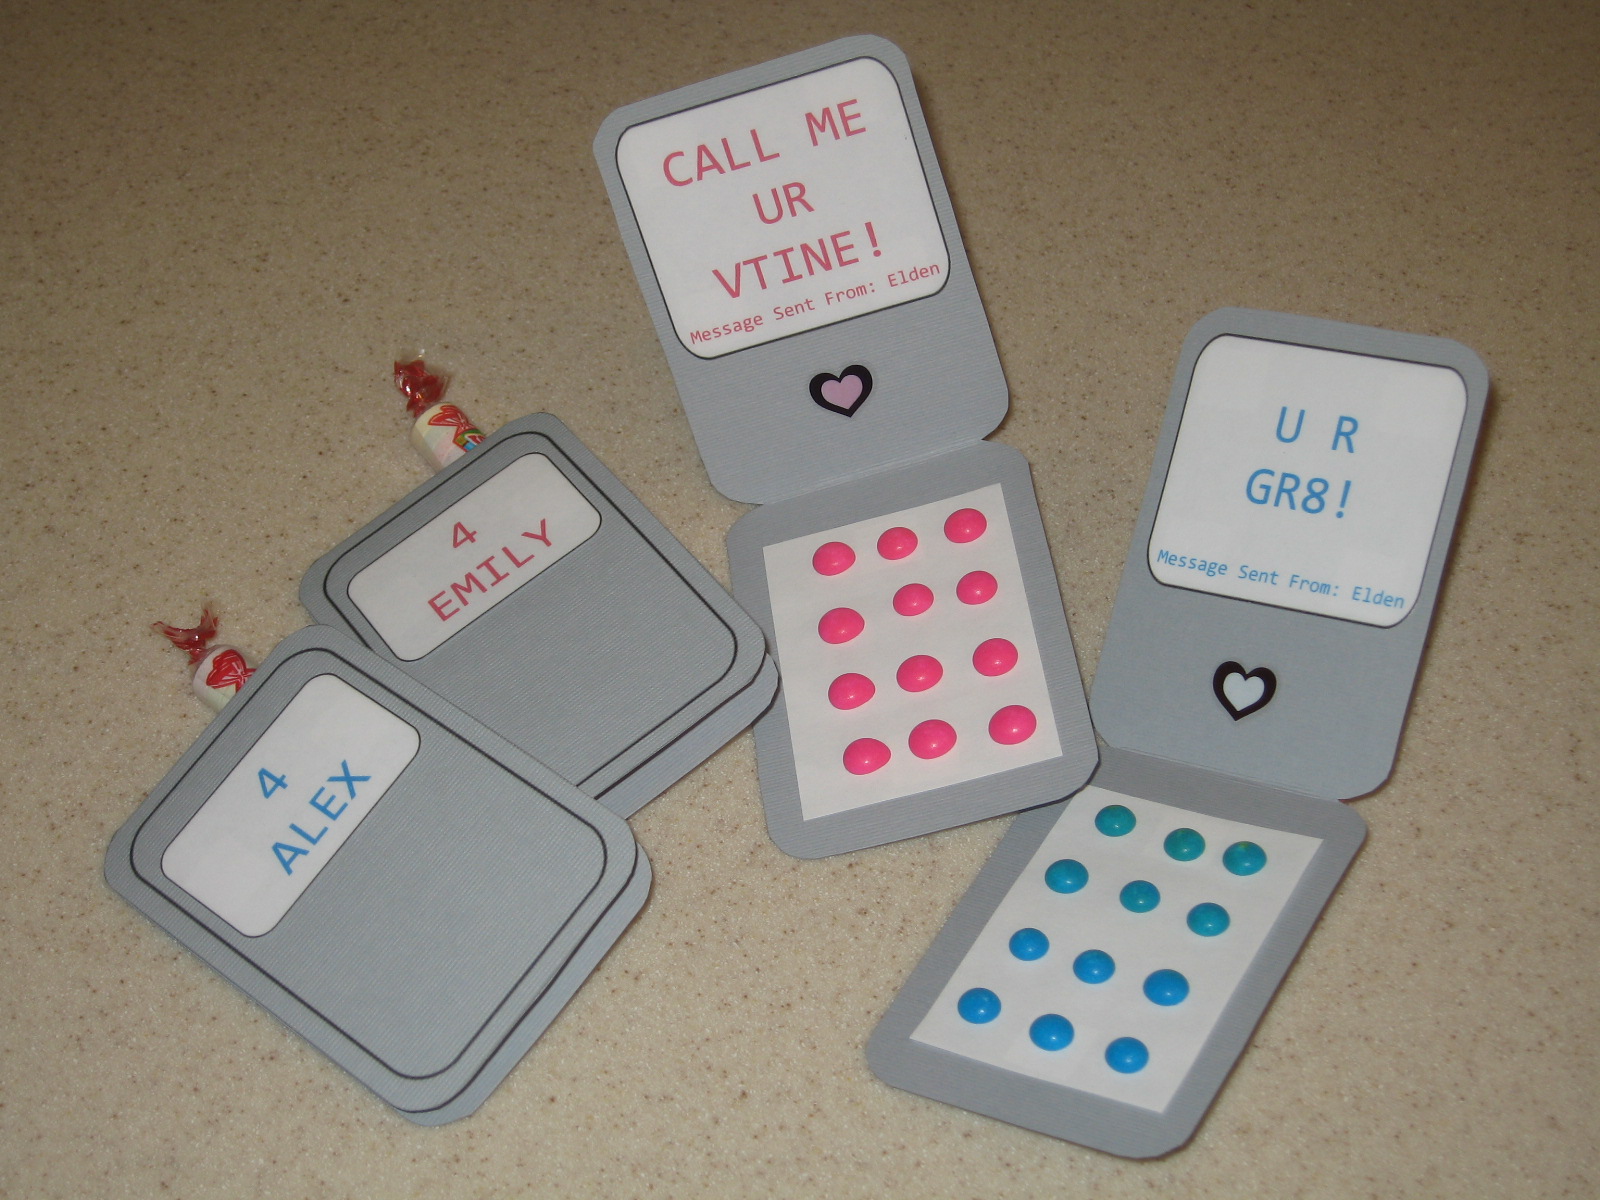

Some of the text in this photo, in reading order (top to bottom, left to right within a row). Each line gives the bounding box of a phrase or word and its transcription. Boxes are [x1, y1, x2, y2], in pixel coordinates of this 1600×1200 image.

[662, 99, 866, 187] CALL ME
[752, 181, 815, 224] UR
[712, 221, 882, 299] VTINE!
[690, 263, 940, 345] Message Sent From: Elden
[1275, 406, 1359, 453] U R
[1246, 469, 1352, 519] GR8!
[452, 521, 477, 548] 4
[427, 518, 552, 622] EMILY
[1157, 550, 1405, 609] Message Sent From: Elden
[257, 767, 288, 799] 4
[271, 759, 372, 876] ALEX
